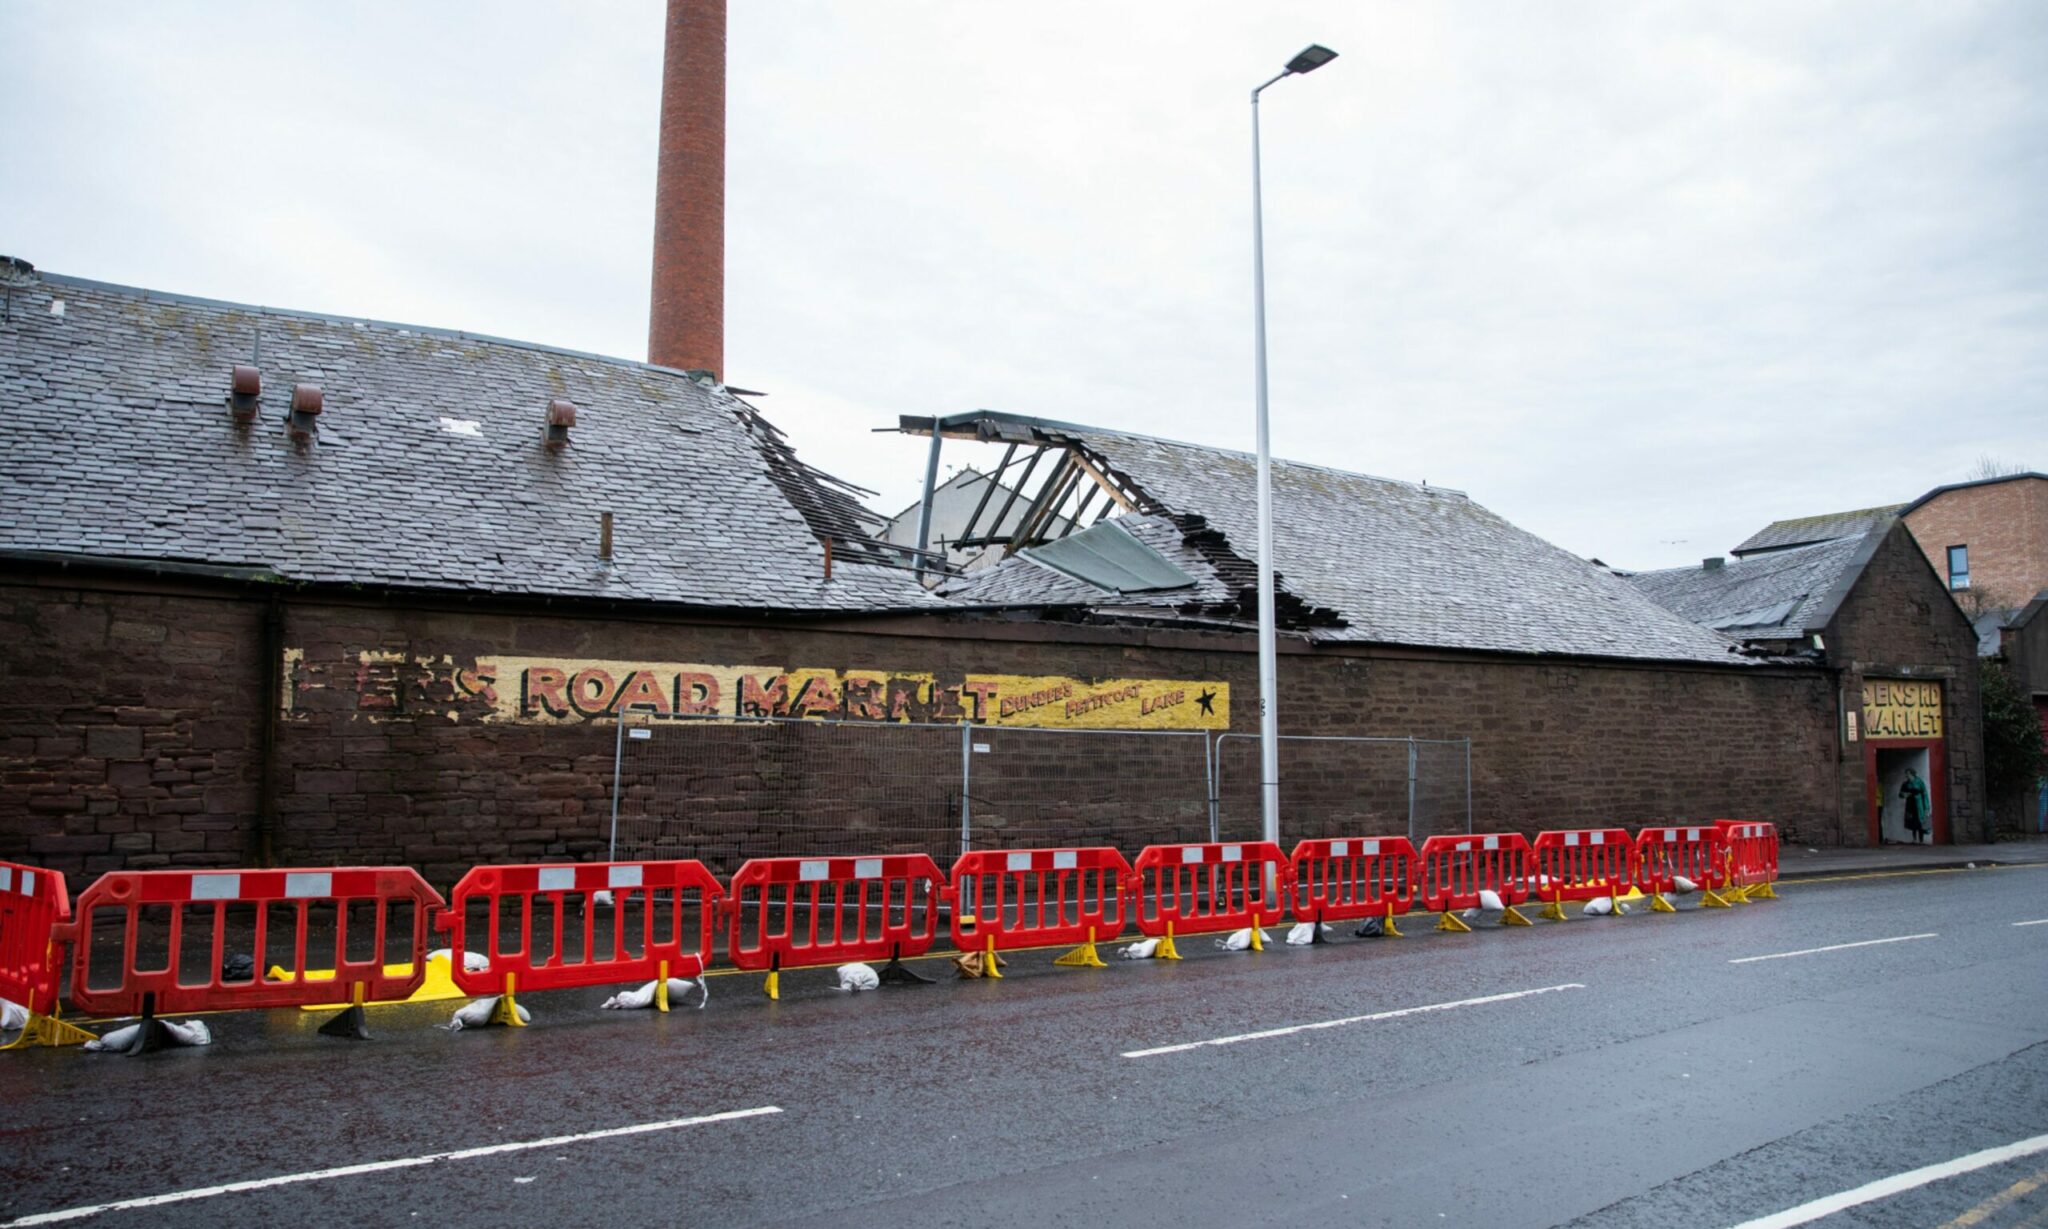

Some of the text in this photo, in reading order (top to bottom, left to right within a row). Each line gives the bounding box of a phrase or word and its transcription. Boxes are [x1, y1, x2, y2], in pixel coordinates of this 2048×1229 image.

[521, 667, 720, 719] ROAD
[1000, 682, 1072, 718] DUNDEE'S
[1141, 689, 1185, 716] LANE
[1865, 710, 1941, 736] MARKET
